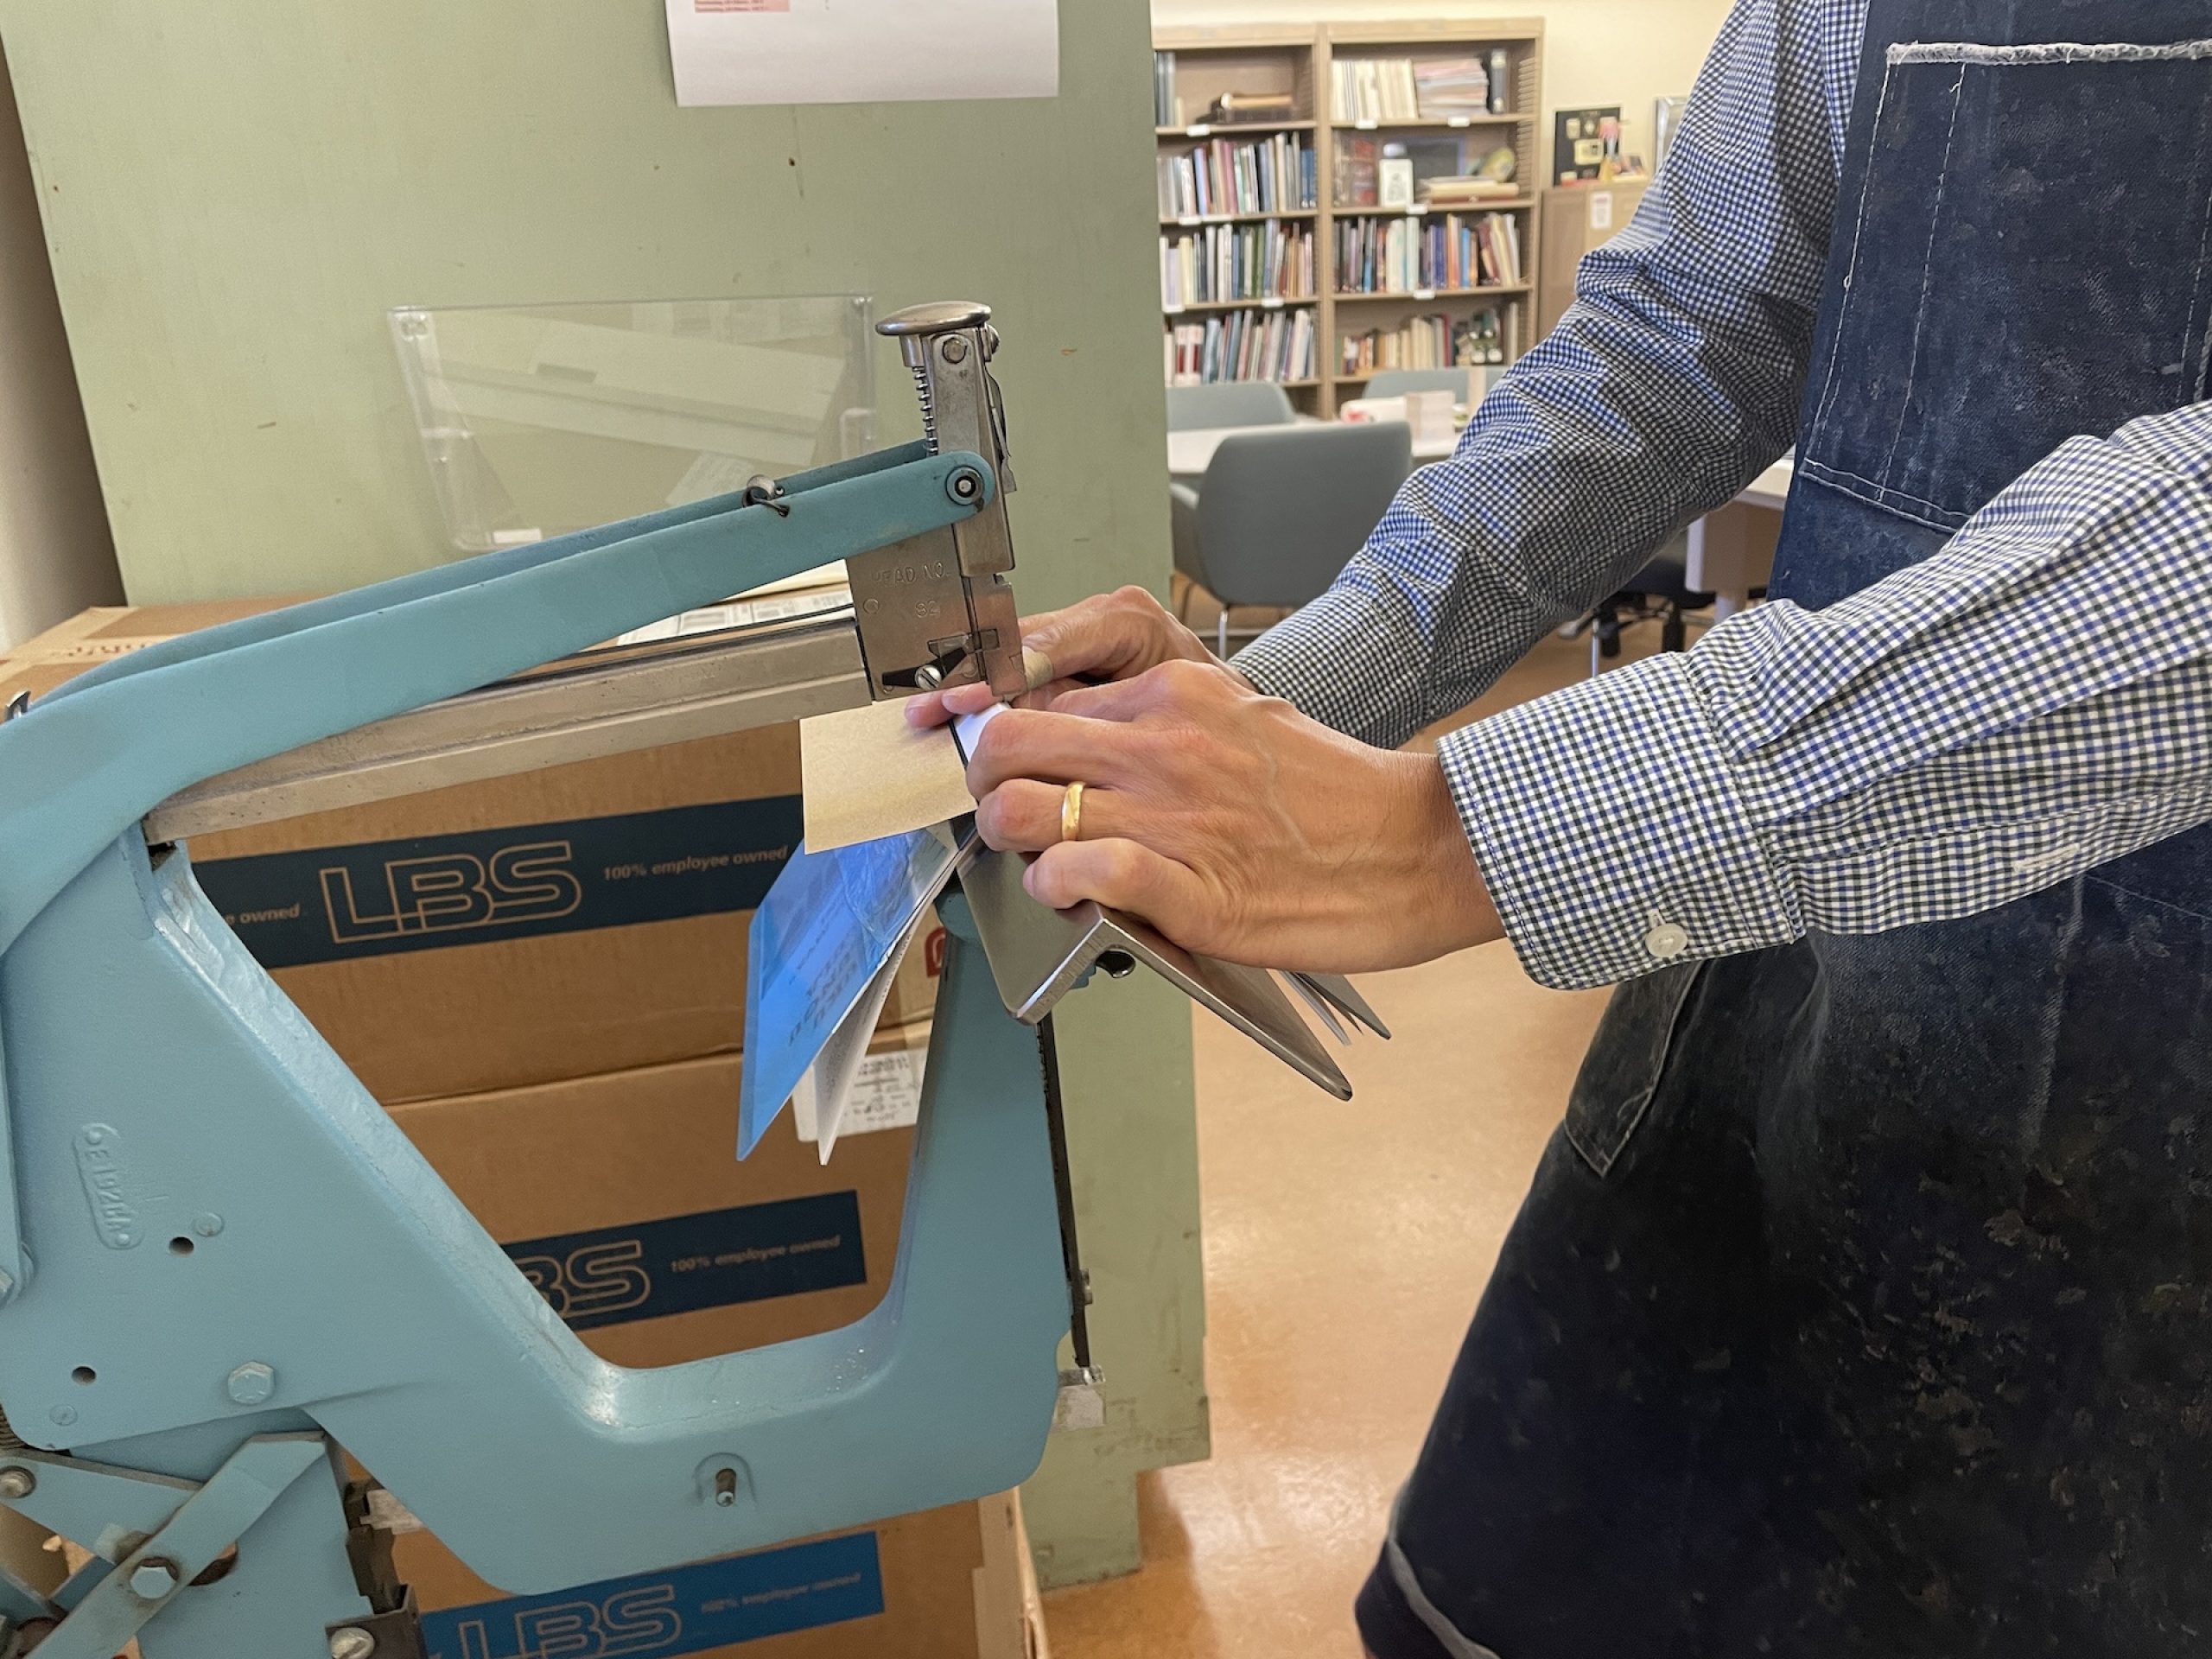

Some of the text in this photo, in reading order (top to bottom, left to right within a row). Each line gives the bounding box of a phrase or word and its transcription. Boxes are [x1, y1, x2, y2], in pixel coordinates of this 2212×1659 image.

[604, 845, 788, 881] 100% employee owned
[320, 840, 582, 944] LBS
[240, 903, 300, 924] owned
